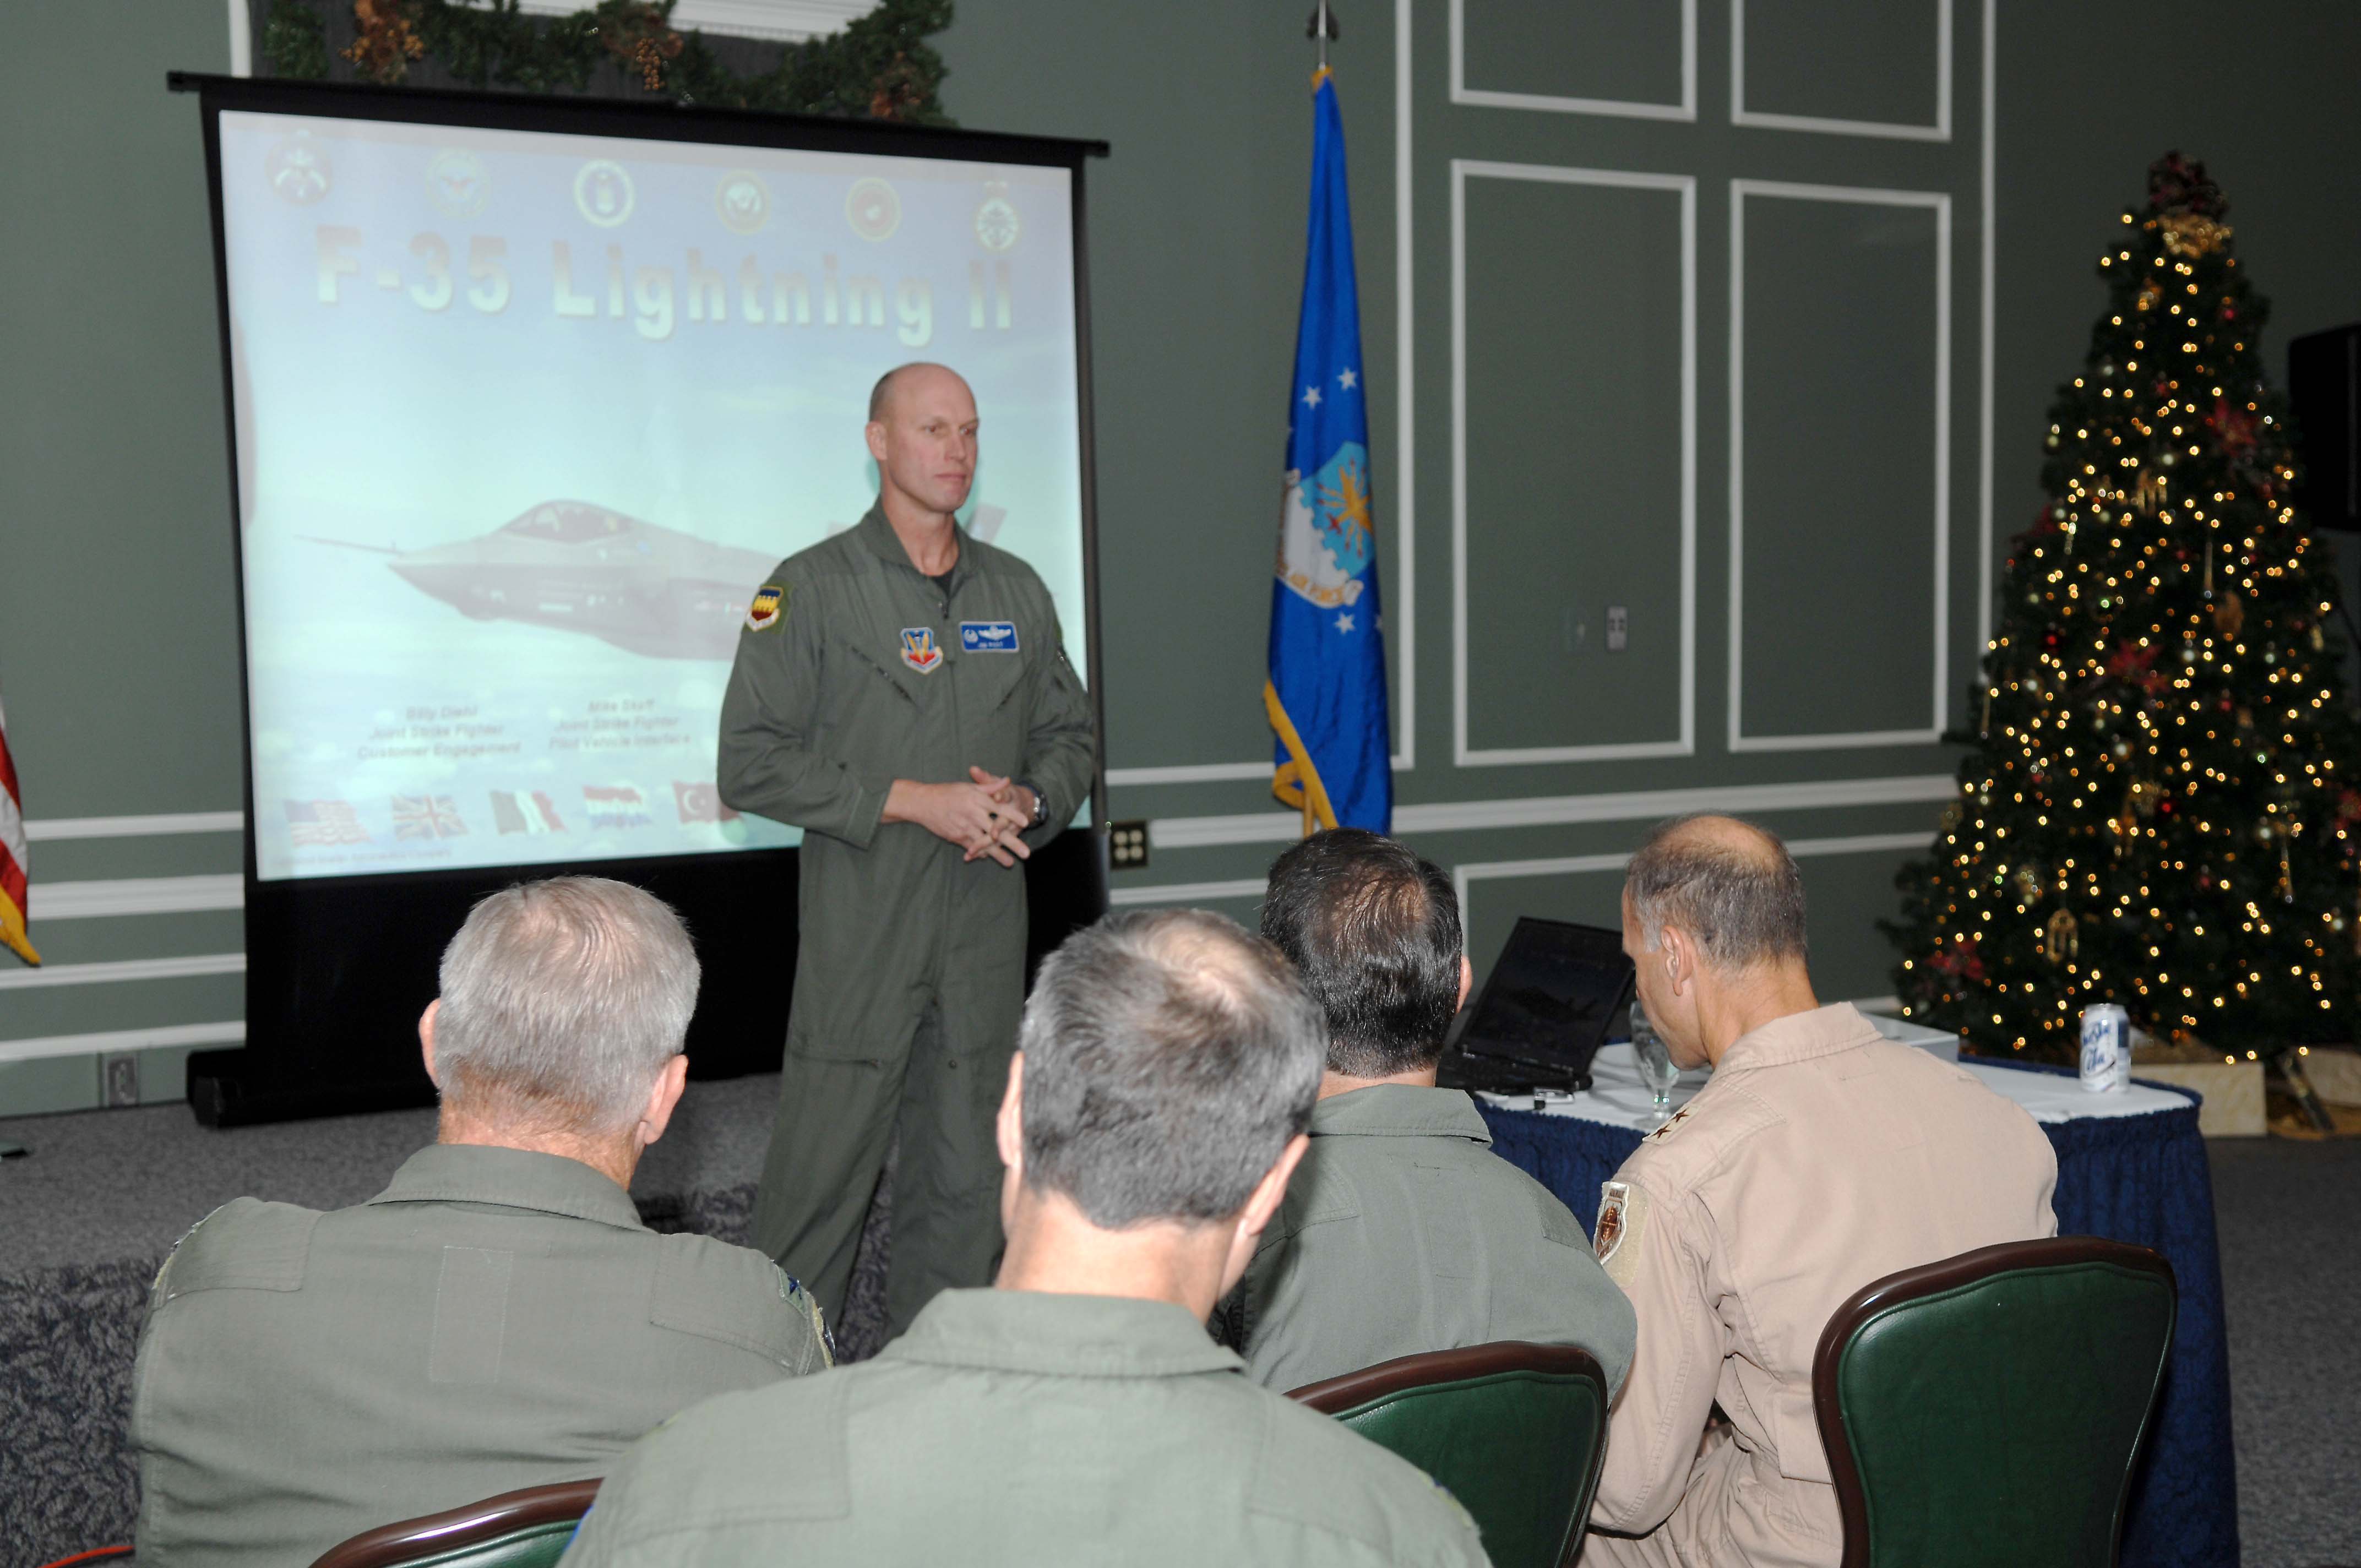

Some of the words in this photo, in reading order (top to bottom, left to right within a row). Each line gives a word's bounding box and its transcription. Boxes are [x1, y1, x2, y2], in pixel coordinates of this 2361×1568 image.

[315, 225, 511, 314] F-35
[551, 238, 933, 347] Lightning
[634, 715, 681, 730] Fighter
[368, 727, 406, 740] Joint
[411, 726, 450, 738] Strike
[455, 724, 504, 738] Fighter
[357, 746, 428, 759] Customer
[433, 742, 520, 758] Engagement
